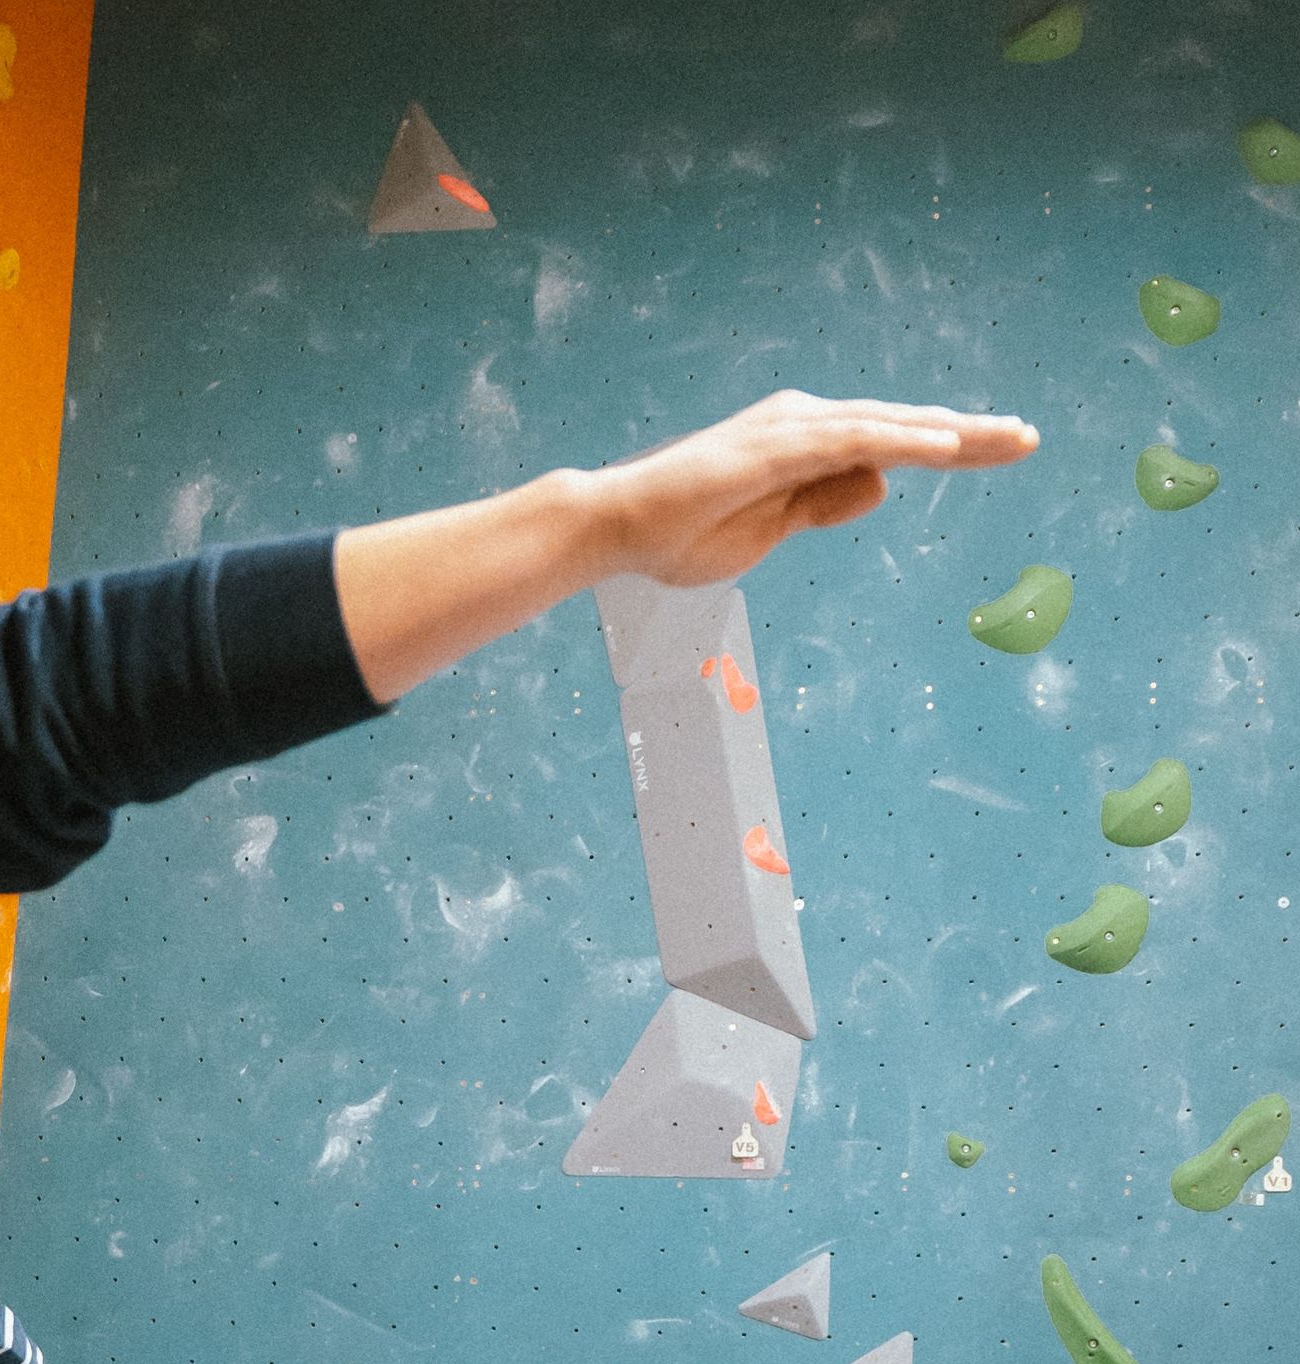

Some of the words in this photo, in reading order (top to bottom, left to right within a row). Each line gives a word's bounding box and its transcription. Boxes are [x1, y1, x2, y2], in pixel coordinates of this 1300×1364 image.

[632, 747, 649, 792] LYNX
[736, 1142, 755, 1153] V5
[1267, 1176, 1288, 1187] V1
